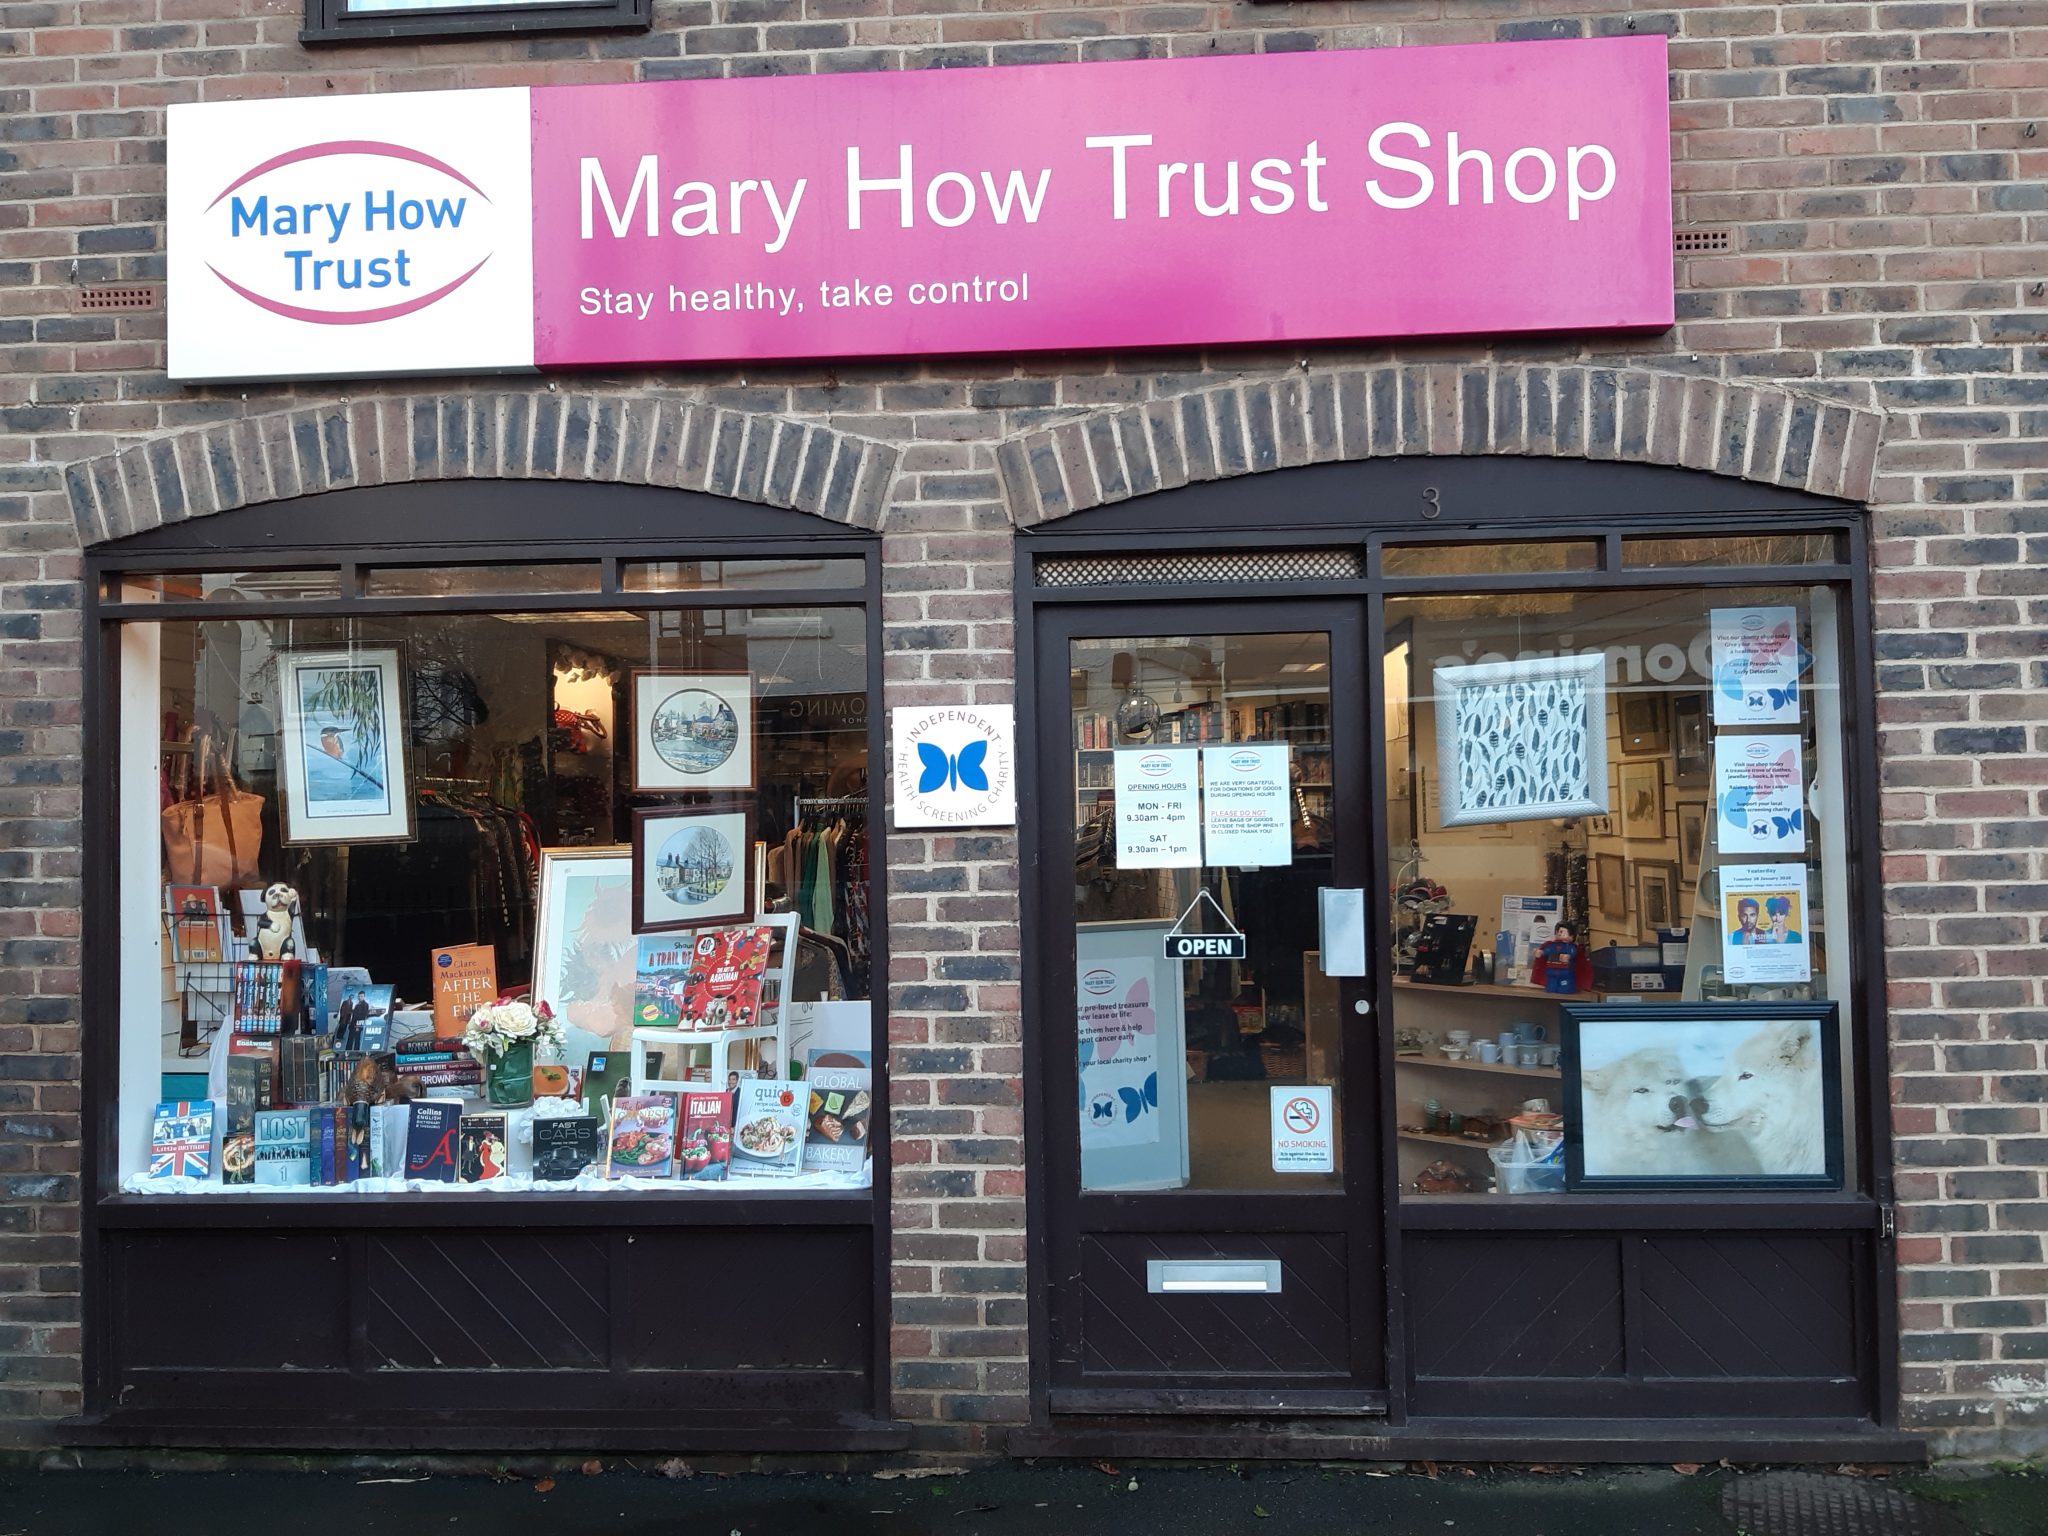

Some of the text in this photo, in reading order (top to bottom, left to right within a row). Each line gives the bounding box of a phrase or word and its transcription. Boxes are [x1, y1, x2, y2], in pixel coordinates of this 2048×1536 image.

[579, 121, 1617, 253] Mary How Trust Shop
[231, 190, 467, 244] Mary How
[284, 249, 411, 291] Trust
[579, 273, 1029, 321] Stay healthy, take control
[1422, 486, 1441, 519] 3
[906, 710, 1002, 743] INDEPENDENT
[897, 752, 918, 801] HEALTH
[987, 751, 1009, 804] CHARITY
[1127, 782, 1187, 791] OPENING HOURS
[916, 800, 987, 822] SCREENING
[1138, 802, 1159, 810] MON
[1126, 814, 1186, 822] 9.30am 4pm
[1149, 834, 1167, 842] SAT
[1169, 845, 1187, 853] 1pm
[674, 942, 695, 950] Shaun
[1177, 939, 1232, 956] OPEN
[453, 960, 477, 968] Clare
[648, 953, 655, 967] A
[656, 951, 680, 966] TRAIL
[440, 967, 492, 979] Mackintosh
[709, 971, 739, 983] AARDMAN
[442, 976, 493, 992] AFTER
[455, 991, 481, 1003] THE
[1084, 1001, 1149, 1013] pre-loved treasures
[1092, 1011, 1109, 1019] lease
[1119, 1010, 1132, 1018] life:
[1085, 1026, 1103, 1034] them
[1105, 1025, 1120, 1033] here
[1127, 1023, 1143, 1033] help
[1118, 1033, 1135, 1043] early
[1097, 1057, 1112, 1065] local
[1112, 1056, 1132, 1065] charity
[1133, 1055, 1148, 1064] shop
[421, 1074, 451, 1085] BROWN
[814, 1075, 862, 1089] GLOBAL
[690, 1100, 722, 1115] ITALIAN
[260, 1116, 308, 1141] LOST
[552, 1121, 578, 1129] FAST
[539, 1128, 591, 1140] CARS
[1278, 1140, 1329, 1148] NO SMOKING.
[805, 1146, 855, 1160] BAKERY
[279, 1166, 287, 1182] 1
